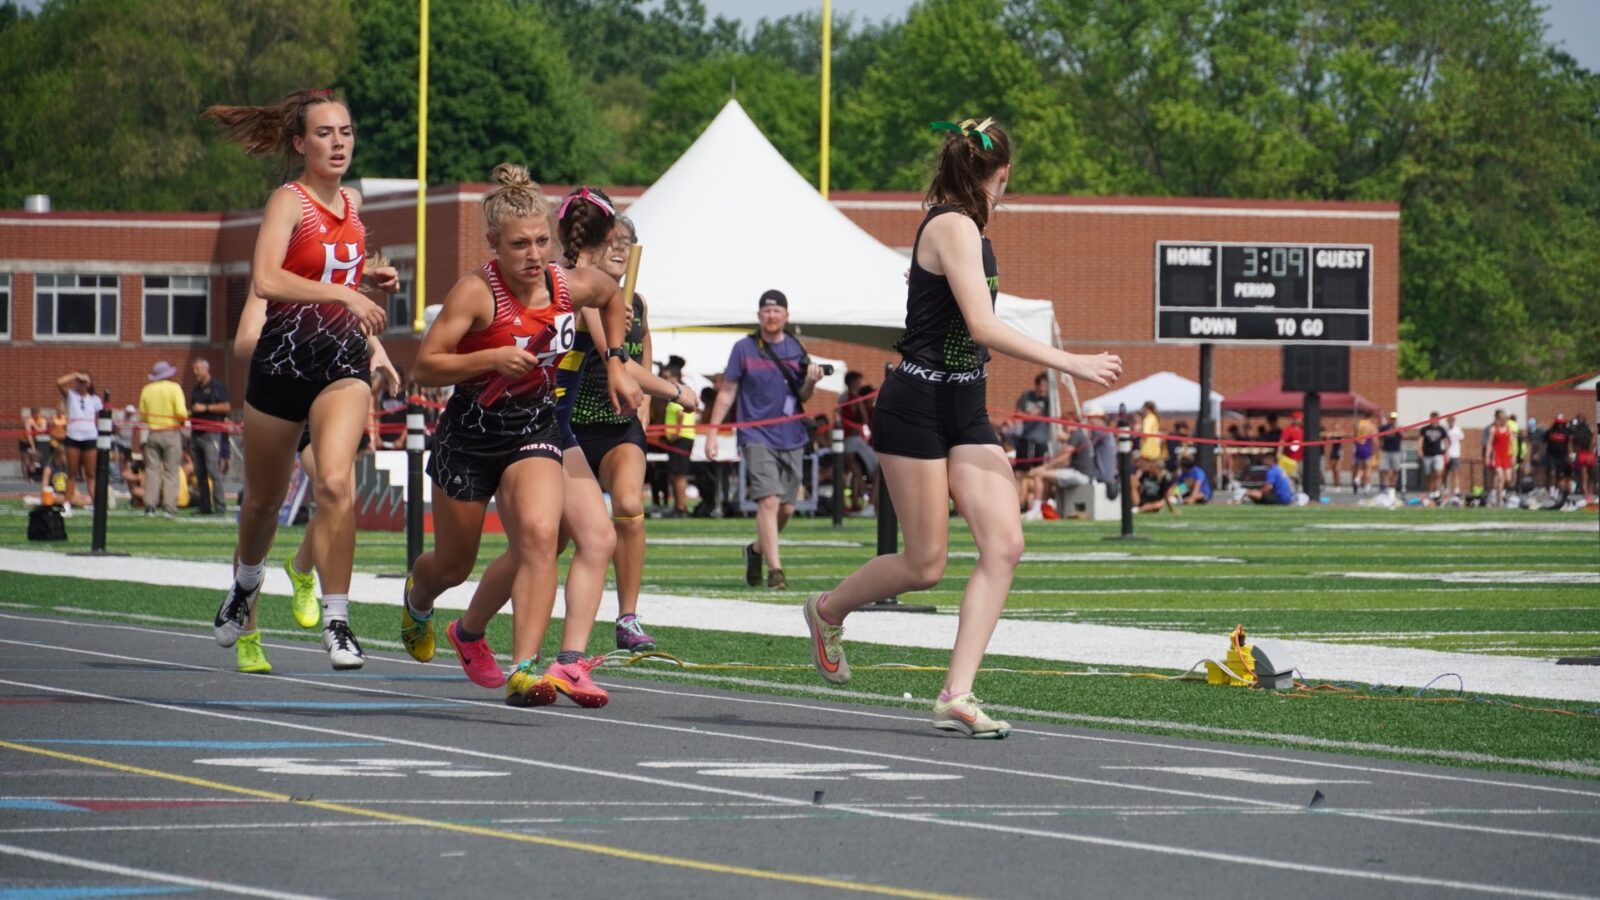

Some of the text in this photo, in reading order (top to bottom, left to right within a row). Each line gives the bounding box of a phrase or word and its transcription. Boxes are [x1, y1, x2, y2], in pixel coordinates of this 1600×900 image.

[321, 242, 363, 286] H
[1166, 247, 1212, 266] HOME
[1242, 248, 1304, 277] 3:09
[1316, 250, 1366, 268] GUEST
[1234, 282, 1276, 298] PERIOD
[560, 314, 574, 350] 6
[1190, 317, 1237, 335] DOWN
[1275, 318, 1324, 336] TO GO
[900, 360, 947, 382] NIKE
[947, 368, 981, 383] PRO
